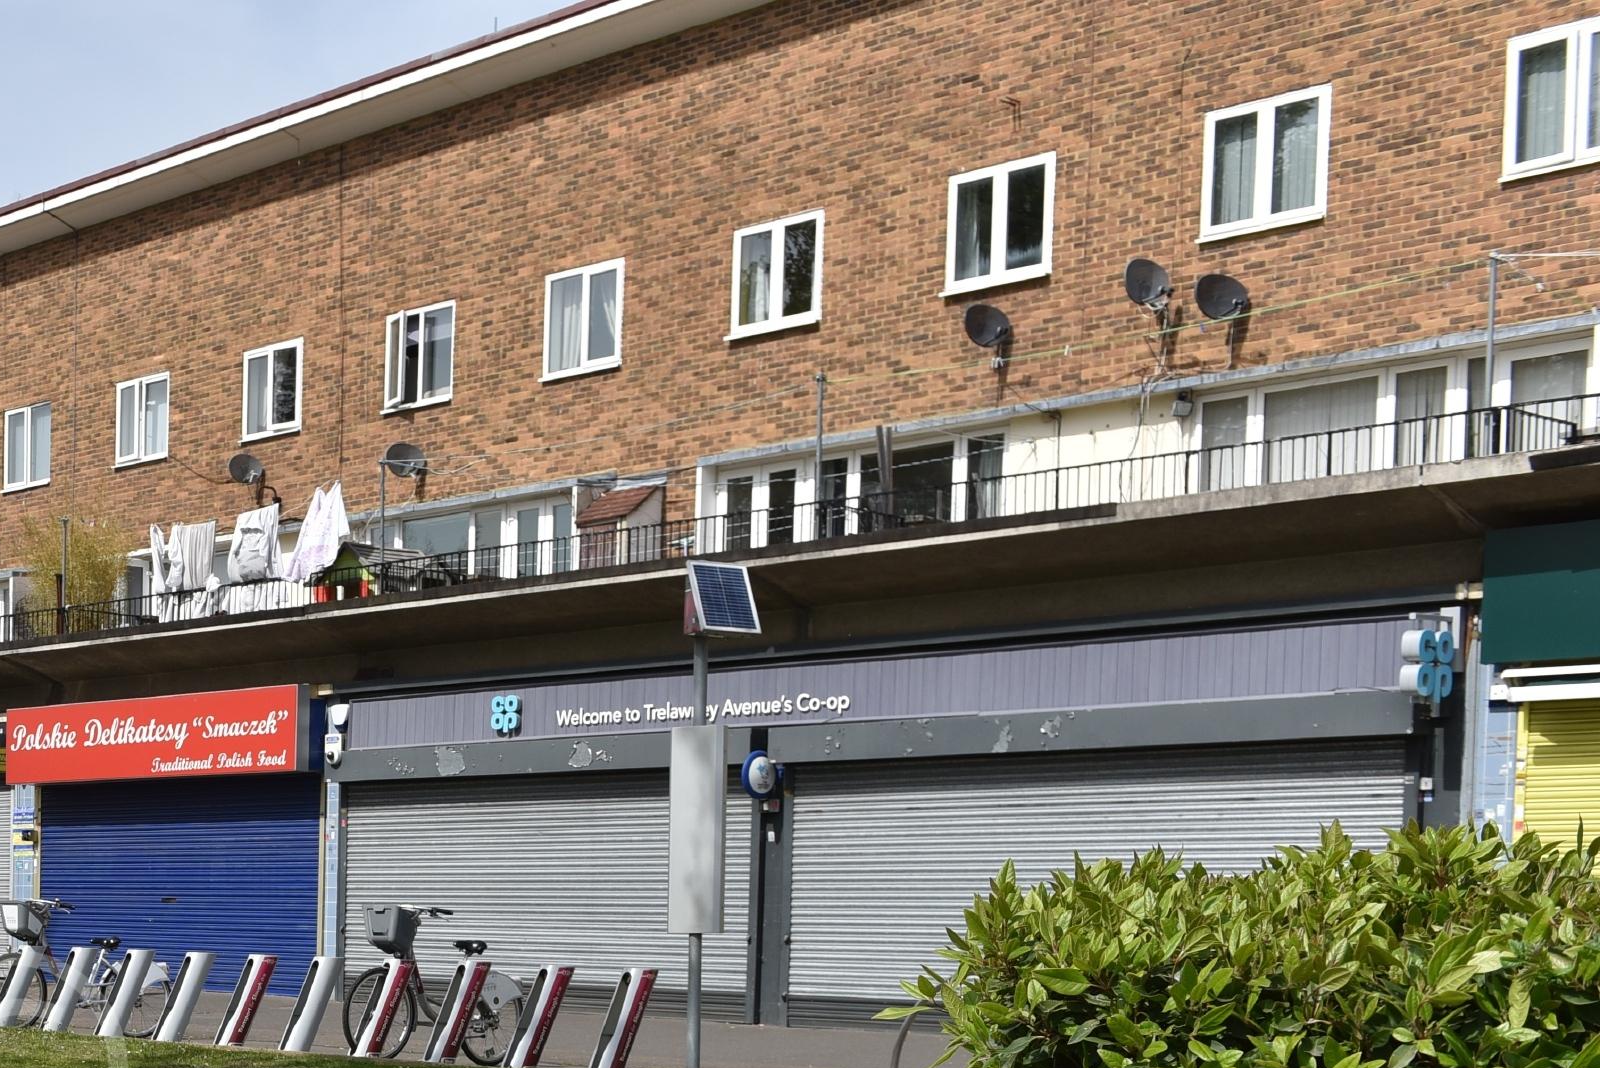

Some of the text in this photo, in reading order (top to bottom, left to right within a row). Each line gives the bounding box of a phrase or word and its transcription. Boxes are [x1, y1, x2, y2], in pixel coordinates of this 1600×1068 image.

[556, 707, 622, 728] Welcome
[624, 705, 641, 722] to
[796, 693, 851, 716] Co-op
[10, 722, 77, 752] Polskie
[83, 715, 189, 750] Delikatesy
[150, 749, 287, 773] Traditional Polish Food
